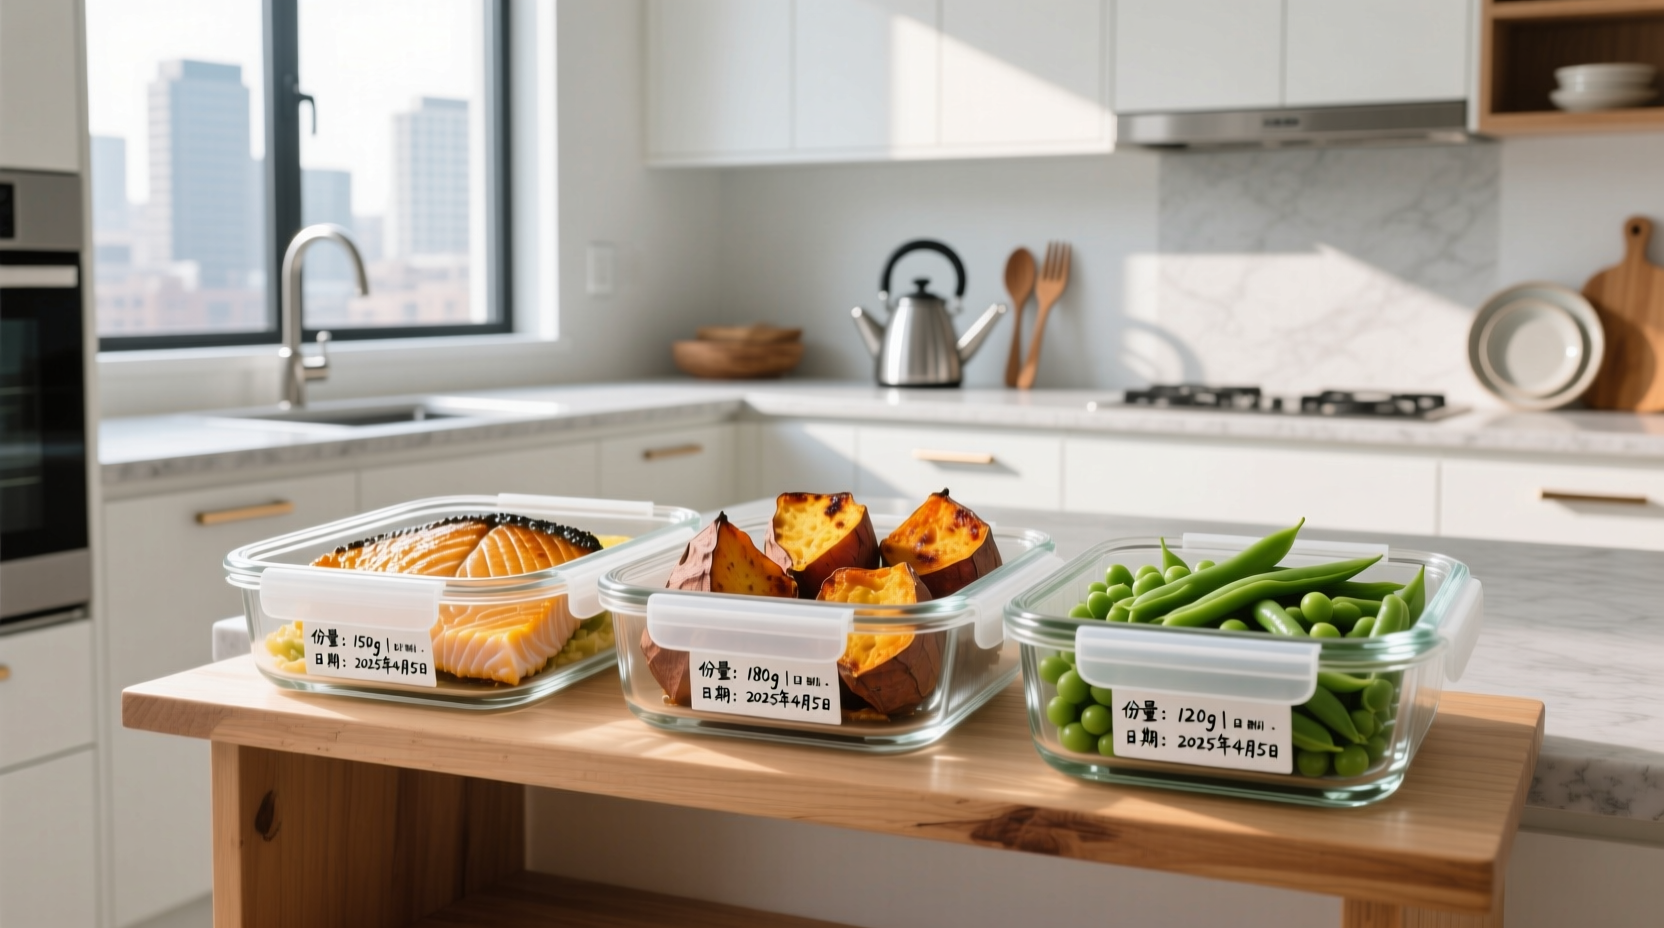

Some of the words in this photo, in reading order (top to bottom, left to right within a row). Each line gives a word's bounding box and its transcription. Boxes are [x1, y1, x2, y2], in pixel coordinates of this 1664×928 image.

[354, 634, 381, 656] 150g
[355, 656, 427, 675] 2025年4月5日
[747, 666, 779, 689] 180g
[746, 689, 830, 711] 2025年4月5日
[1178, 707, 1216, 732] 120g
[1177, 733, 1278, 759] 2025年4月5日
